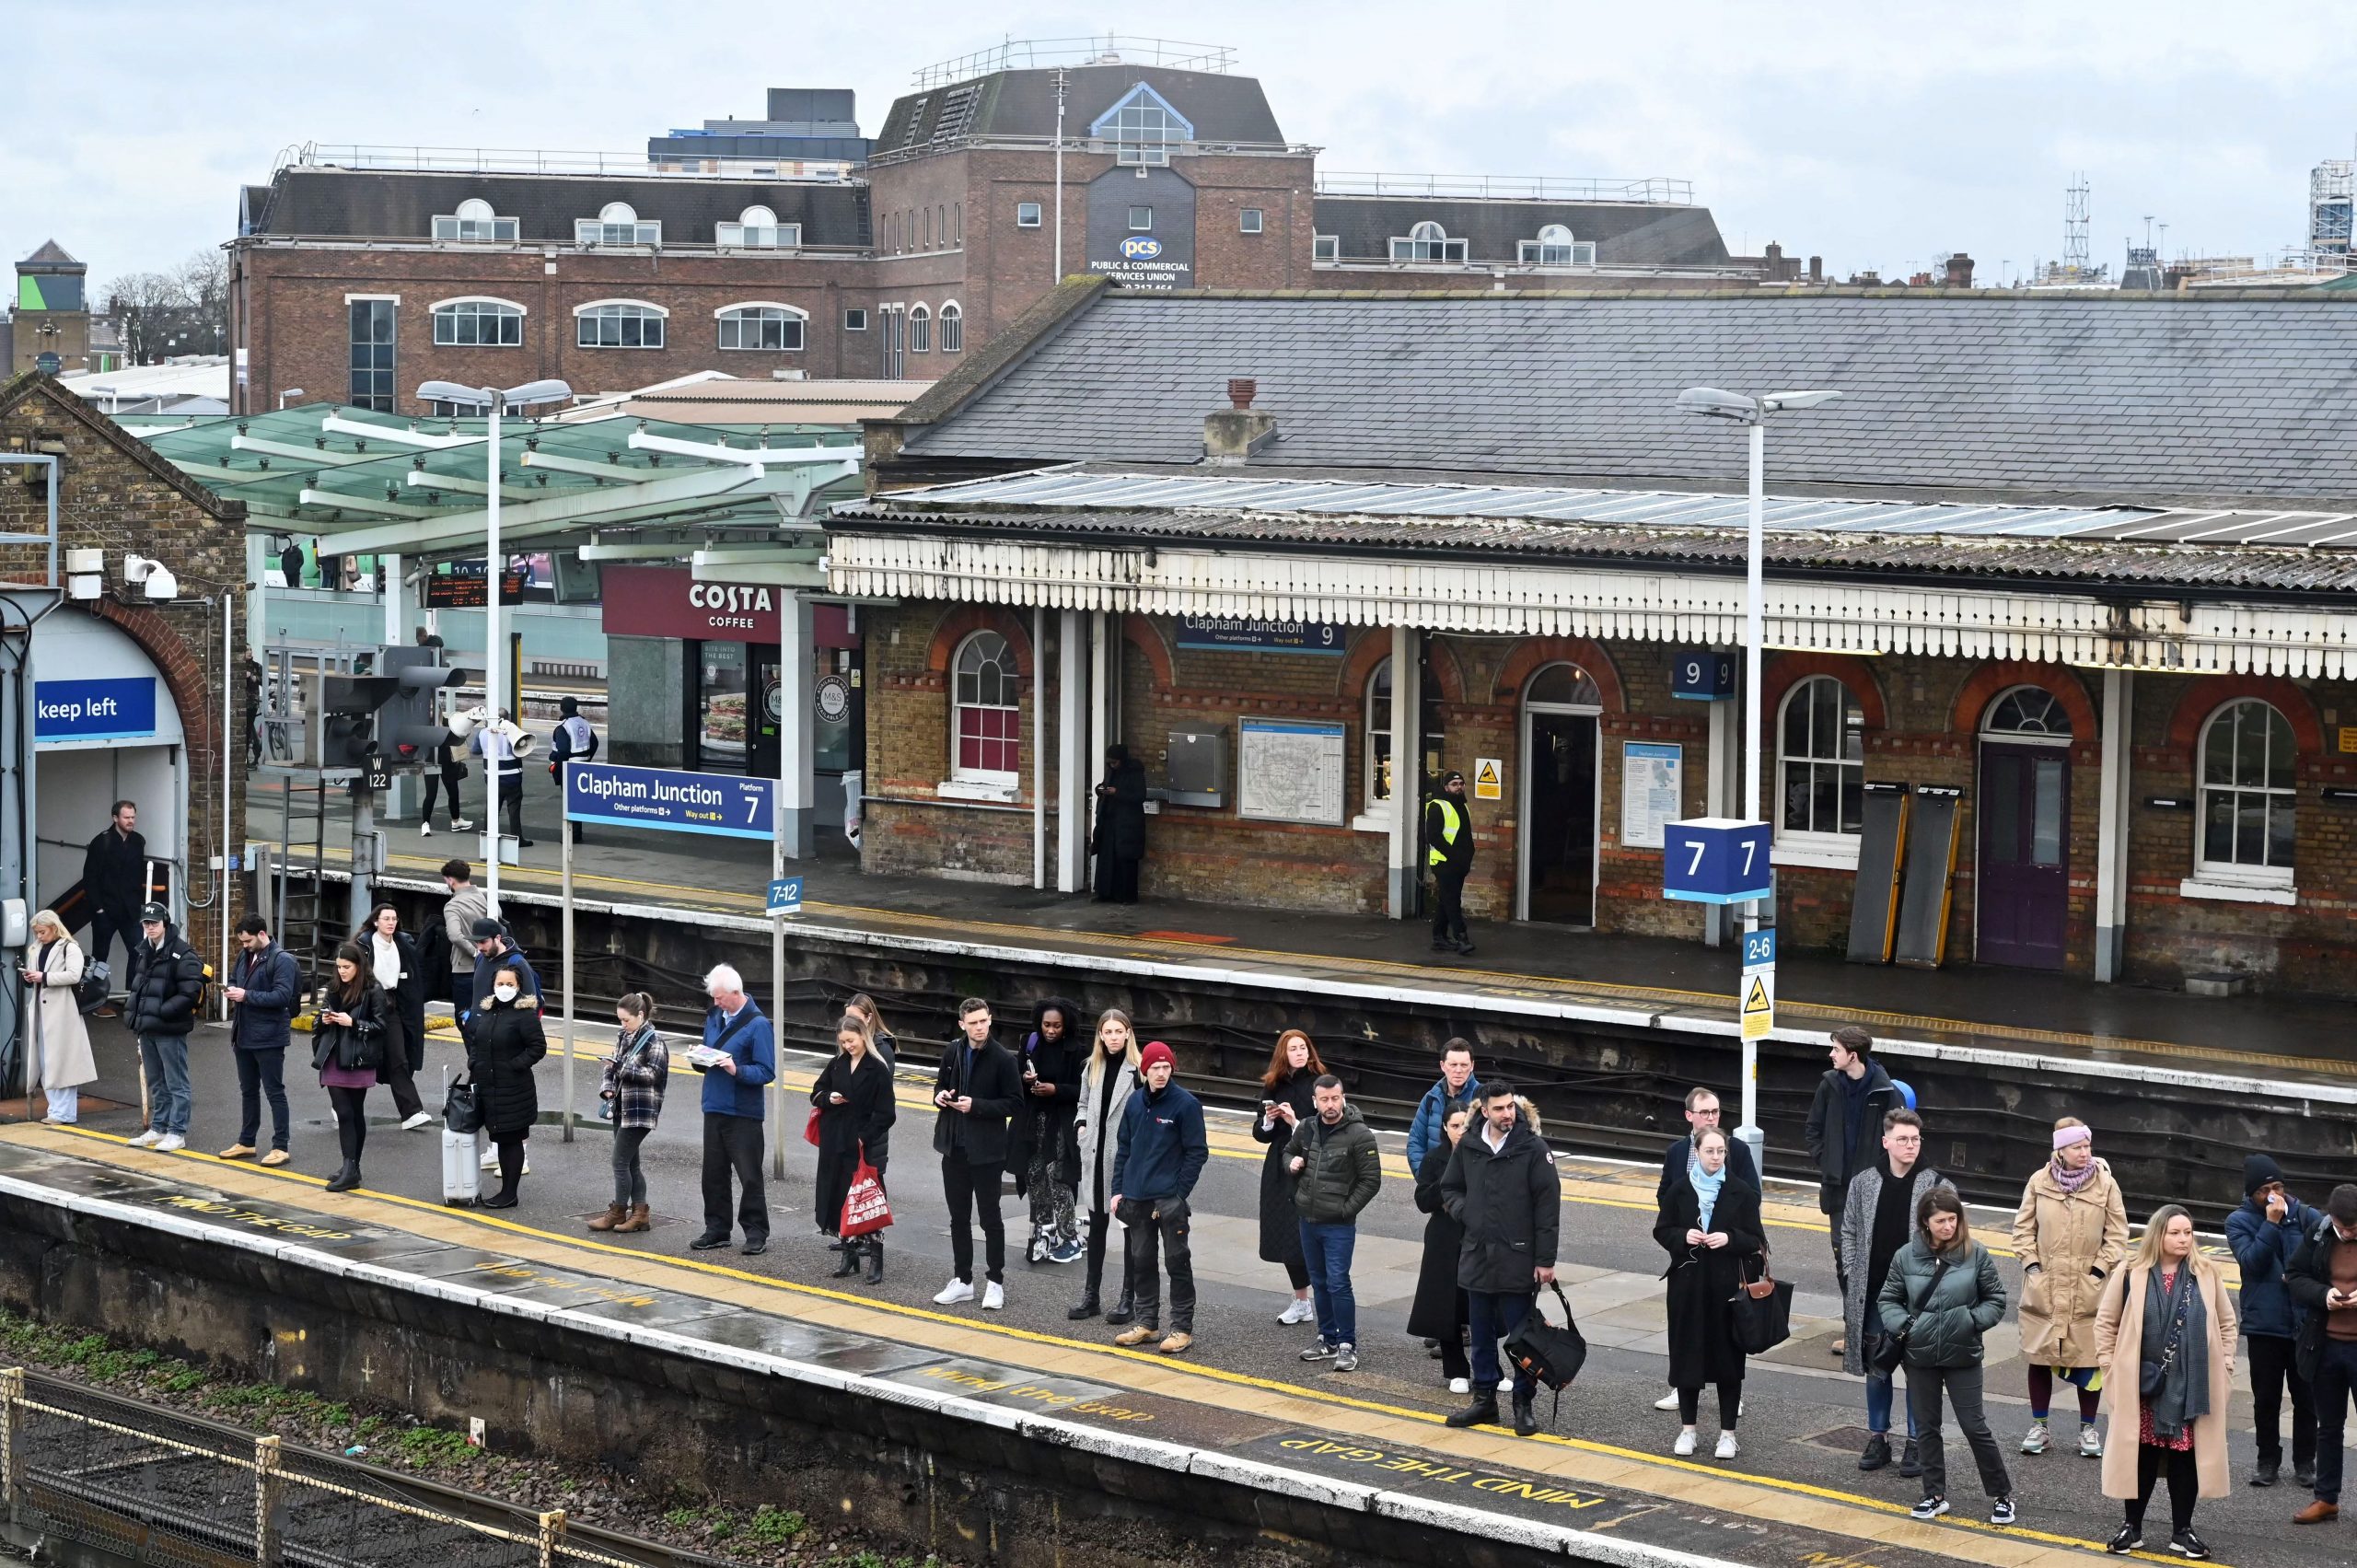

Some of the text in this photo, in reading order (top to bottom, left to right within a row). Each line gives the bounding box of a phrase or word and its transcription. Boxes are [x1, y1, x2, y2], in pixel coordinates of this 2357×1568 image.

[1125, 241, 1157, 258] pcs
[1091, 261, 1190, 272] PUBLIC & COMMERCIAL
[1147, 273, 1176, 281] UNION
[690, 584, 772, 613] COSTA
[709, 616, 754, 629] COFFEE
[1185, 615, 1304, 633] Clapham Junction
[1229, 634, 1251, 643] platforms
[1321, 626, 1333, 645] 9
[1686, 662, 1701, 684] 9
[1721, 663, 1729, 685] 9
[824, 692, 842, 702] M&S
[39, 697, 117, 722] keep left
[372, 758, 382, 771] W
[369, 773, 386, 787] 122
[577, 772, 722, 806] Clapham Junction
[739, 783, 764, 793] Platform
[613, 802, 657, 815] Other platforms
[685, 810, 698, 819] Way
[744, 796, 759, 823] 7
[1685, 841, 1705, 876] 7
[1741, 840, 1756, 876] 7
[772, 884, 797, 903] 7-12
[1749, 937, 1771, 960] 2-6
[153, 1195, 352, 1239] MIND THE GAP
[916, 1366, 1007, 1391] Mind
[1009, 1386, 1076, 1404] the
[1280, 1439, 1606, 1509] MIND THE GAP
